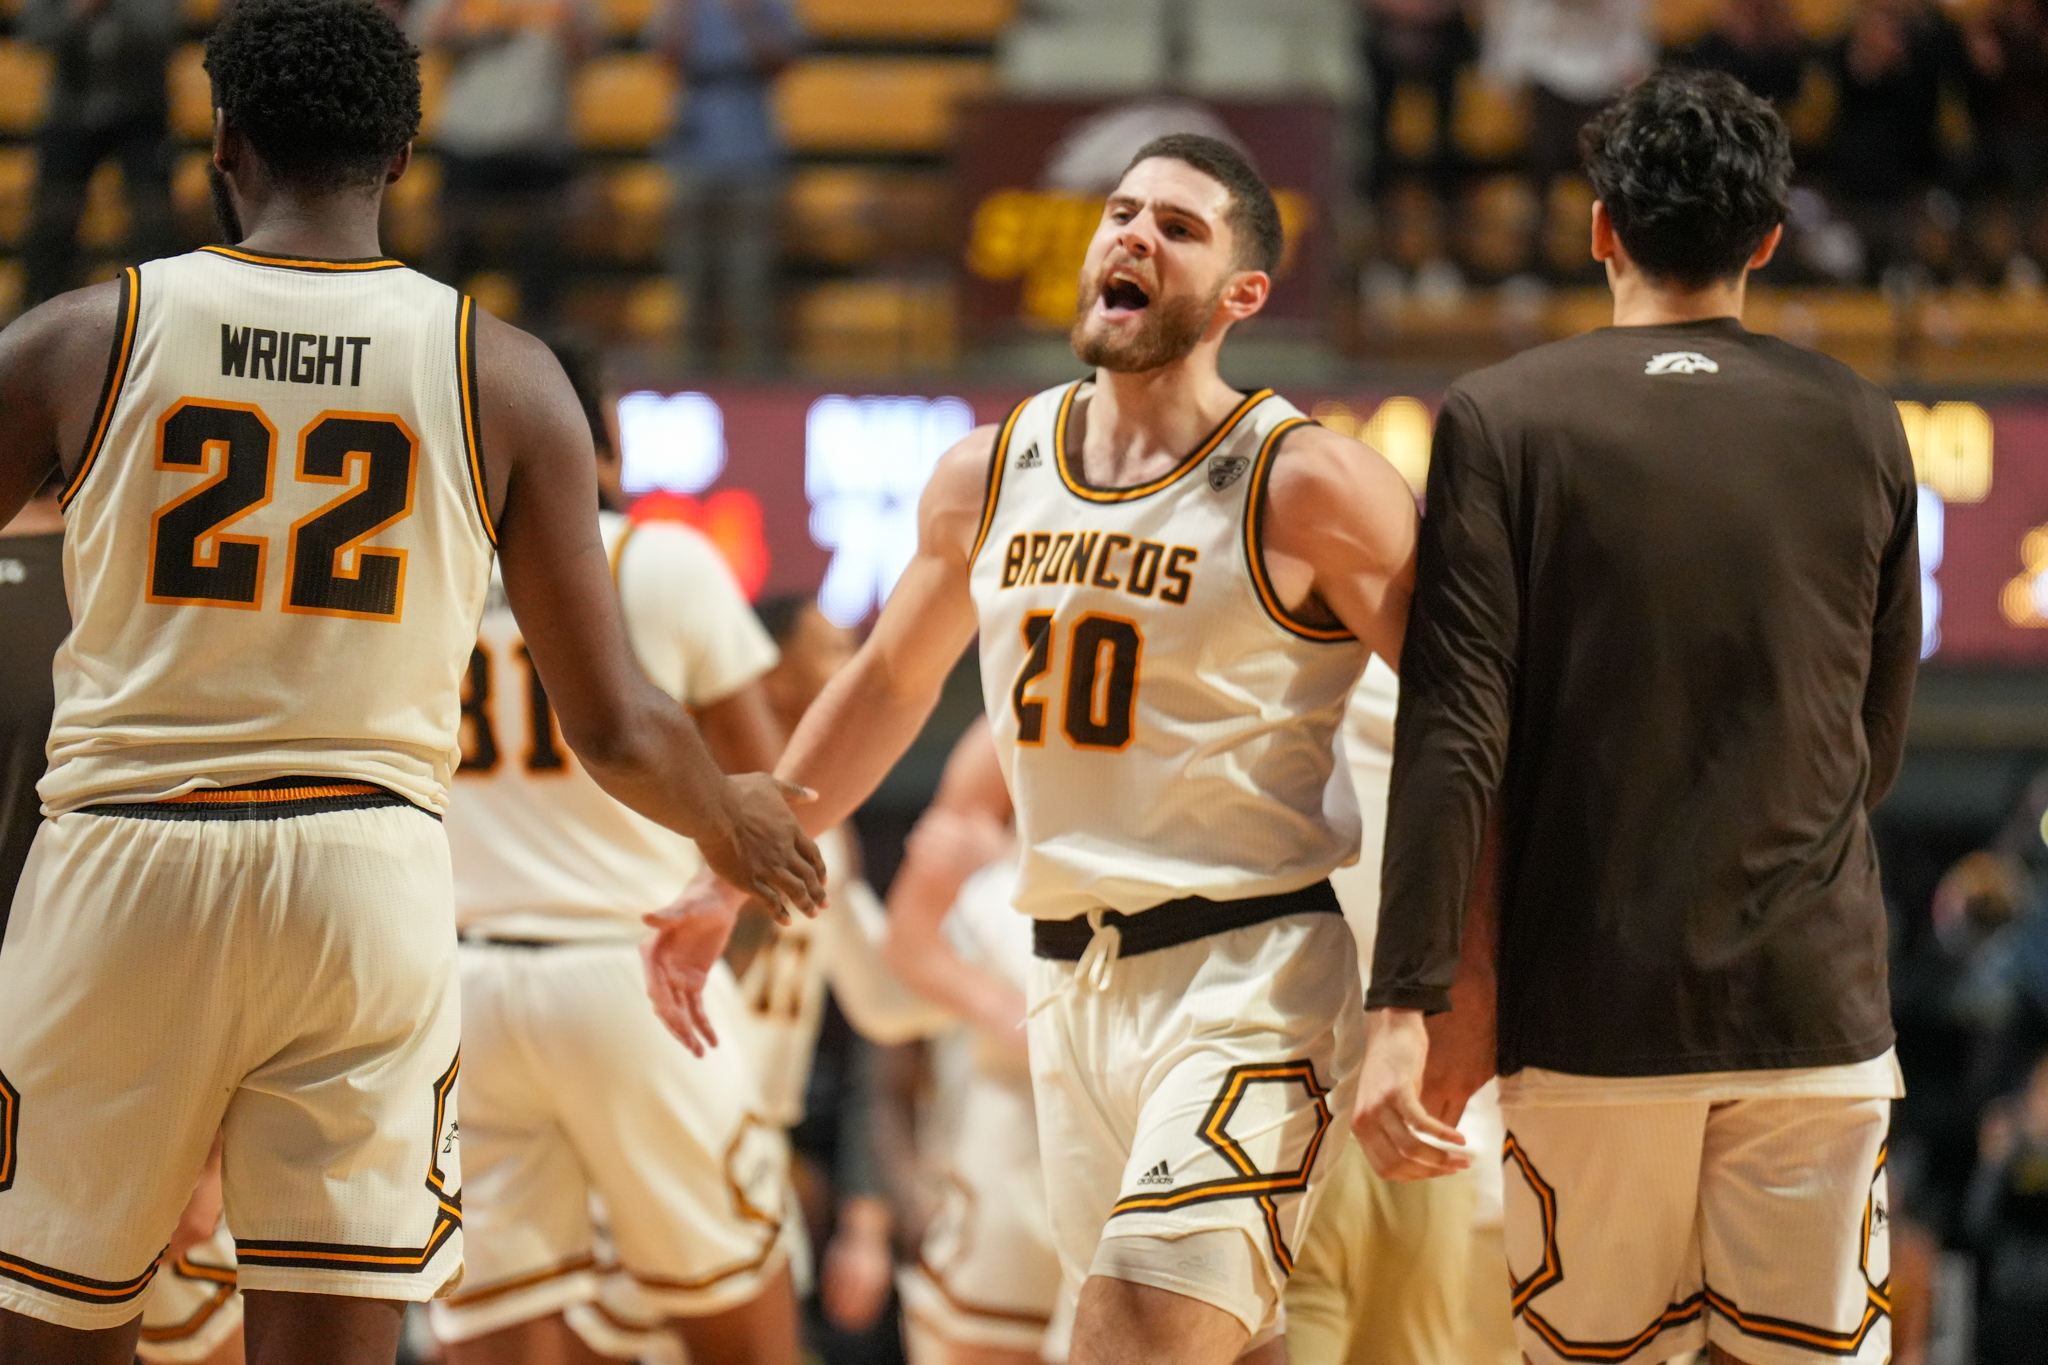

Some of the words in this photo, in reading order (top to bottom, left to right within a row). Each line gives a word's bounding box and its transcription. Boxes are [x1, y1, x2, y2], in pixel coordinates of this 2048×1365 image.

[221, 323, 371, 387] WRIGHT
[145, 396, 420, 624] 22
[1000, 531, 1199, 606] BRONCOS
